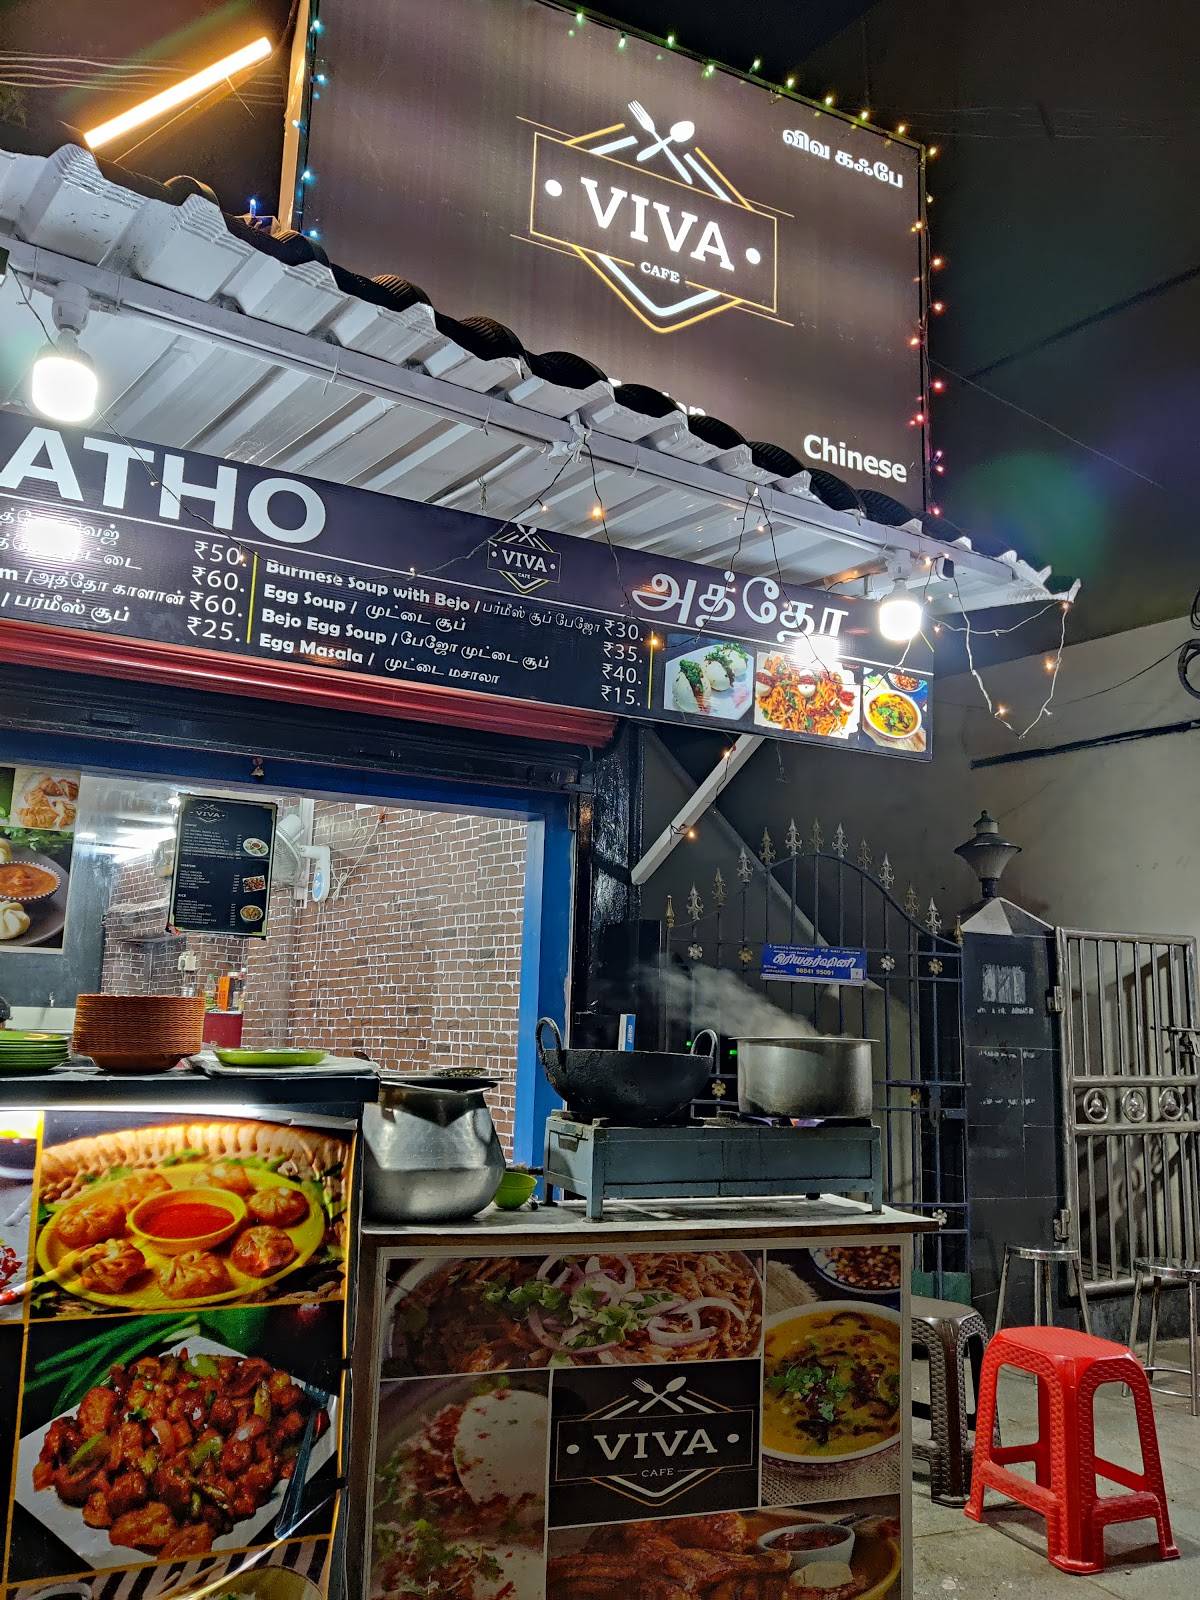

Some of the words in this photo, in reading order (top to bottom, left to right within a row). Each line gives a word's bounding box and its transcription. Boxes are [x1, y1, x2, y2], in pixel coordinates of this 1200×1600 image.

[782, 129, 830, 160] விவ
[834, 149, 903, 188] கஃபே
[580, 176, 735, 272] VIVA
[640, 261, 680, 284] CAFE
[804, 434, 907, 483] Chinese
[0, 426, 326, 543] ATHO
[192, 565, 245, 592] ₹60.
[502, 549, 548, 573] VIVA
[518, 572, 530, 580] CAFE
[14, 593, 86, 614] பர்மீஸ்
[186, 616, 240, 642] ₹25.
[112, 584, 186, 605] காளான்
[189, 591, 243, 617] ₹60.
[264, 583, 298, 604] Egg
[304, 592, 346, 613] Soup
[366, 604, 431, 625] முட்டை
[603, 641, 643, 664] ₹35.
[266, 559, 343, 586] Burmese
[348, 576, 388, 597] Soup
[393, 587, 430, 603] with
[435, 592, 470, 612] Bejo
[483, 601, 526, 619] பர்மீஸ்
[604, 619, 644, 642] ₹30.
[631, 570, 849, 643] அத்தோ
[259, 633, 295, 654] Egg
[299, 639, 363, 664] Masala
[384, 657, 444, 676] முட்டை
[448, 668, 501, 685] மசாலா
[600, 684, 642, 707] ₹15.
[261, 608, 302, 629] Bejo
[307, 616, 341, 637] Egg
[346, 623, 386, 645] Soup
[401, 631, 458, 656] பேஜோ
[461, 645, 518, 664] முட்டை
[602, 663, 642, 685] ₹40.
[196, 810, 221, 818] VIVA
[593, 1428, 718, 1461] VIVA
[641, 1467, 674, 1478] CAFE
